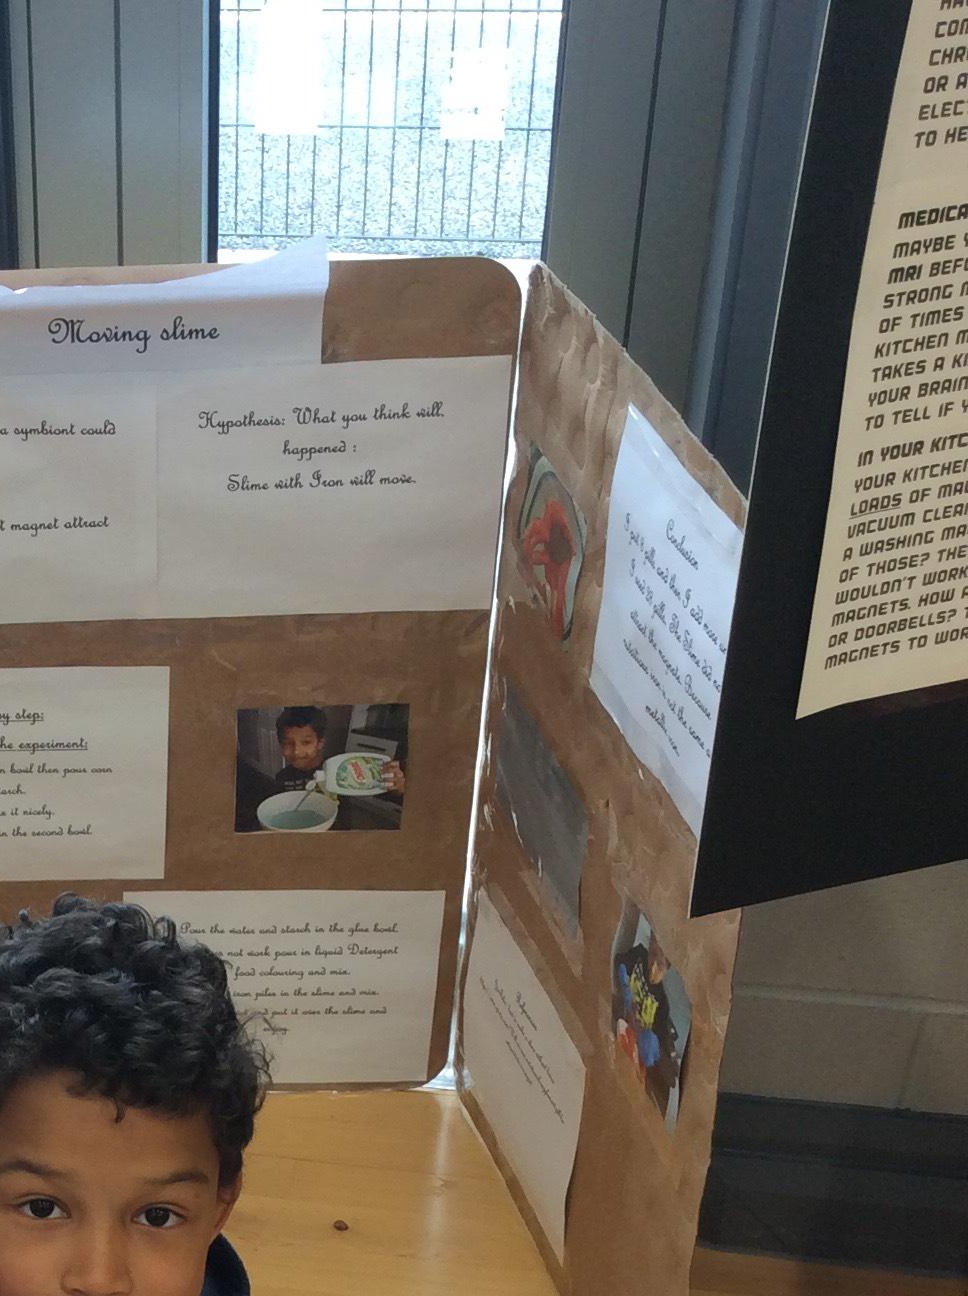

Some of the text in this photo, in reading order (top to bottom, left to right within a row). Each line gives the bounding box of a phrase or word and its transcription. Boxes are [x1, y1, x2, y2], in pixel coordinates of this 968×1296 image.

[928, 46, 968, 67] CHR
[923, 75, 949, 94] OR
[918, 100, 968, 121] ELEC
[914, 130, 937, 148] TO
[892, 234, 956, 259] MAYBE
[887, 263, 924, 285] MRI
[882, 283, 954, 309] STRONG
[878, 305, 965, 334] OF TIMES
[48, 315, 220, 354] Moving slime
[874, 332, 949, 359] KITCHEN
[872, 356, 946, 383] TAKES A
[868, 385, 911, 408] YOUR
[198, 410, 286, 435] Hypothesis:
[292, 407, 336, 425] What
[342, 412, 367, 429] you
[373, 403, 411, 420] think
[864, 414, 885, 432] TO
[892, 406, 931, 426] TELL
[938, 402, 955, 418] IF
[0, 428, 8, 436] a
[14, 420, 76, 441] symbiont
[80, 419, 116, 436] could
[283, 440, 346, 461] happened
[857, 450, 874, 468] IN
[880, 440, 925, 462] YOUR
[227, 473, 269, 492] Slime
[274, 472, 303, 489] with
[309, 469, 344, 488] Iron
[349, 469, 376, 486] will
[854, 472, 896, 493] YOUR
[850, 493, 902, 519] LOADS
[909, 488, 932, 504] OF
[11, 517, 58, 537] magnet
[64, 516, 110, 530] attract
[847, 512, 916, 539] VACUUM
[842, 524, 968, 562] A WASHING MA
[839, 552, 930, 583] OF THOSE?
[835, 576, 916, 605] WOULDN'T
[831, 598, 911, 627] MAGNETS.
[917, 588, 955, 608] HOW
[828, 631, 848, 648] OR
[854, 608, 957, 642] DOORBELLS?
[824, 640, 900, 670] MAGNETS
[908, 635, 928, 651] TO
[15, 708, 45, 726] step:
[18, 737, 88, 755] experiment:
[9, 763, 33, 775] bowl
[37, 763, 59, 774] then
[62, 767, 87, 778] pour
[10, 807, 19, 816] it
[22, 804, 55, 820] nicely.
[12, 826, 27, 837] the
[31, 827, 64, 837] second
[210, 923, 225, 934] the
[229, 926, 255, 934] water
[259, 925, 278, 934] and
[280, 922, 311, 933] starch
[329, 922, 344, 933] the
[348, 922, 369, 937] glue
[227, 948, 243, 957] not
[247, 945, 270, 957] work
[275, 950, 297, 960] pour
[314, 944, 343, 959] liquid
[347, 943, 399, 959] Detergent
[234, 966, 256, 981] food
[259, 965, 304, 981] colouring
[308, 966, 326, 976] and
[293, 987, 307, 996] the
[311, 986, 335, 996] slime
[338, 988, 356, 996] and
[271, 1008, 287, 1019] put
[324, 1006, 338, 1015] the
[342, 1005, 366, 1015] slime
[369, 1006, 387, 1014] and
